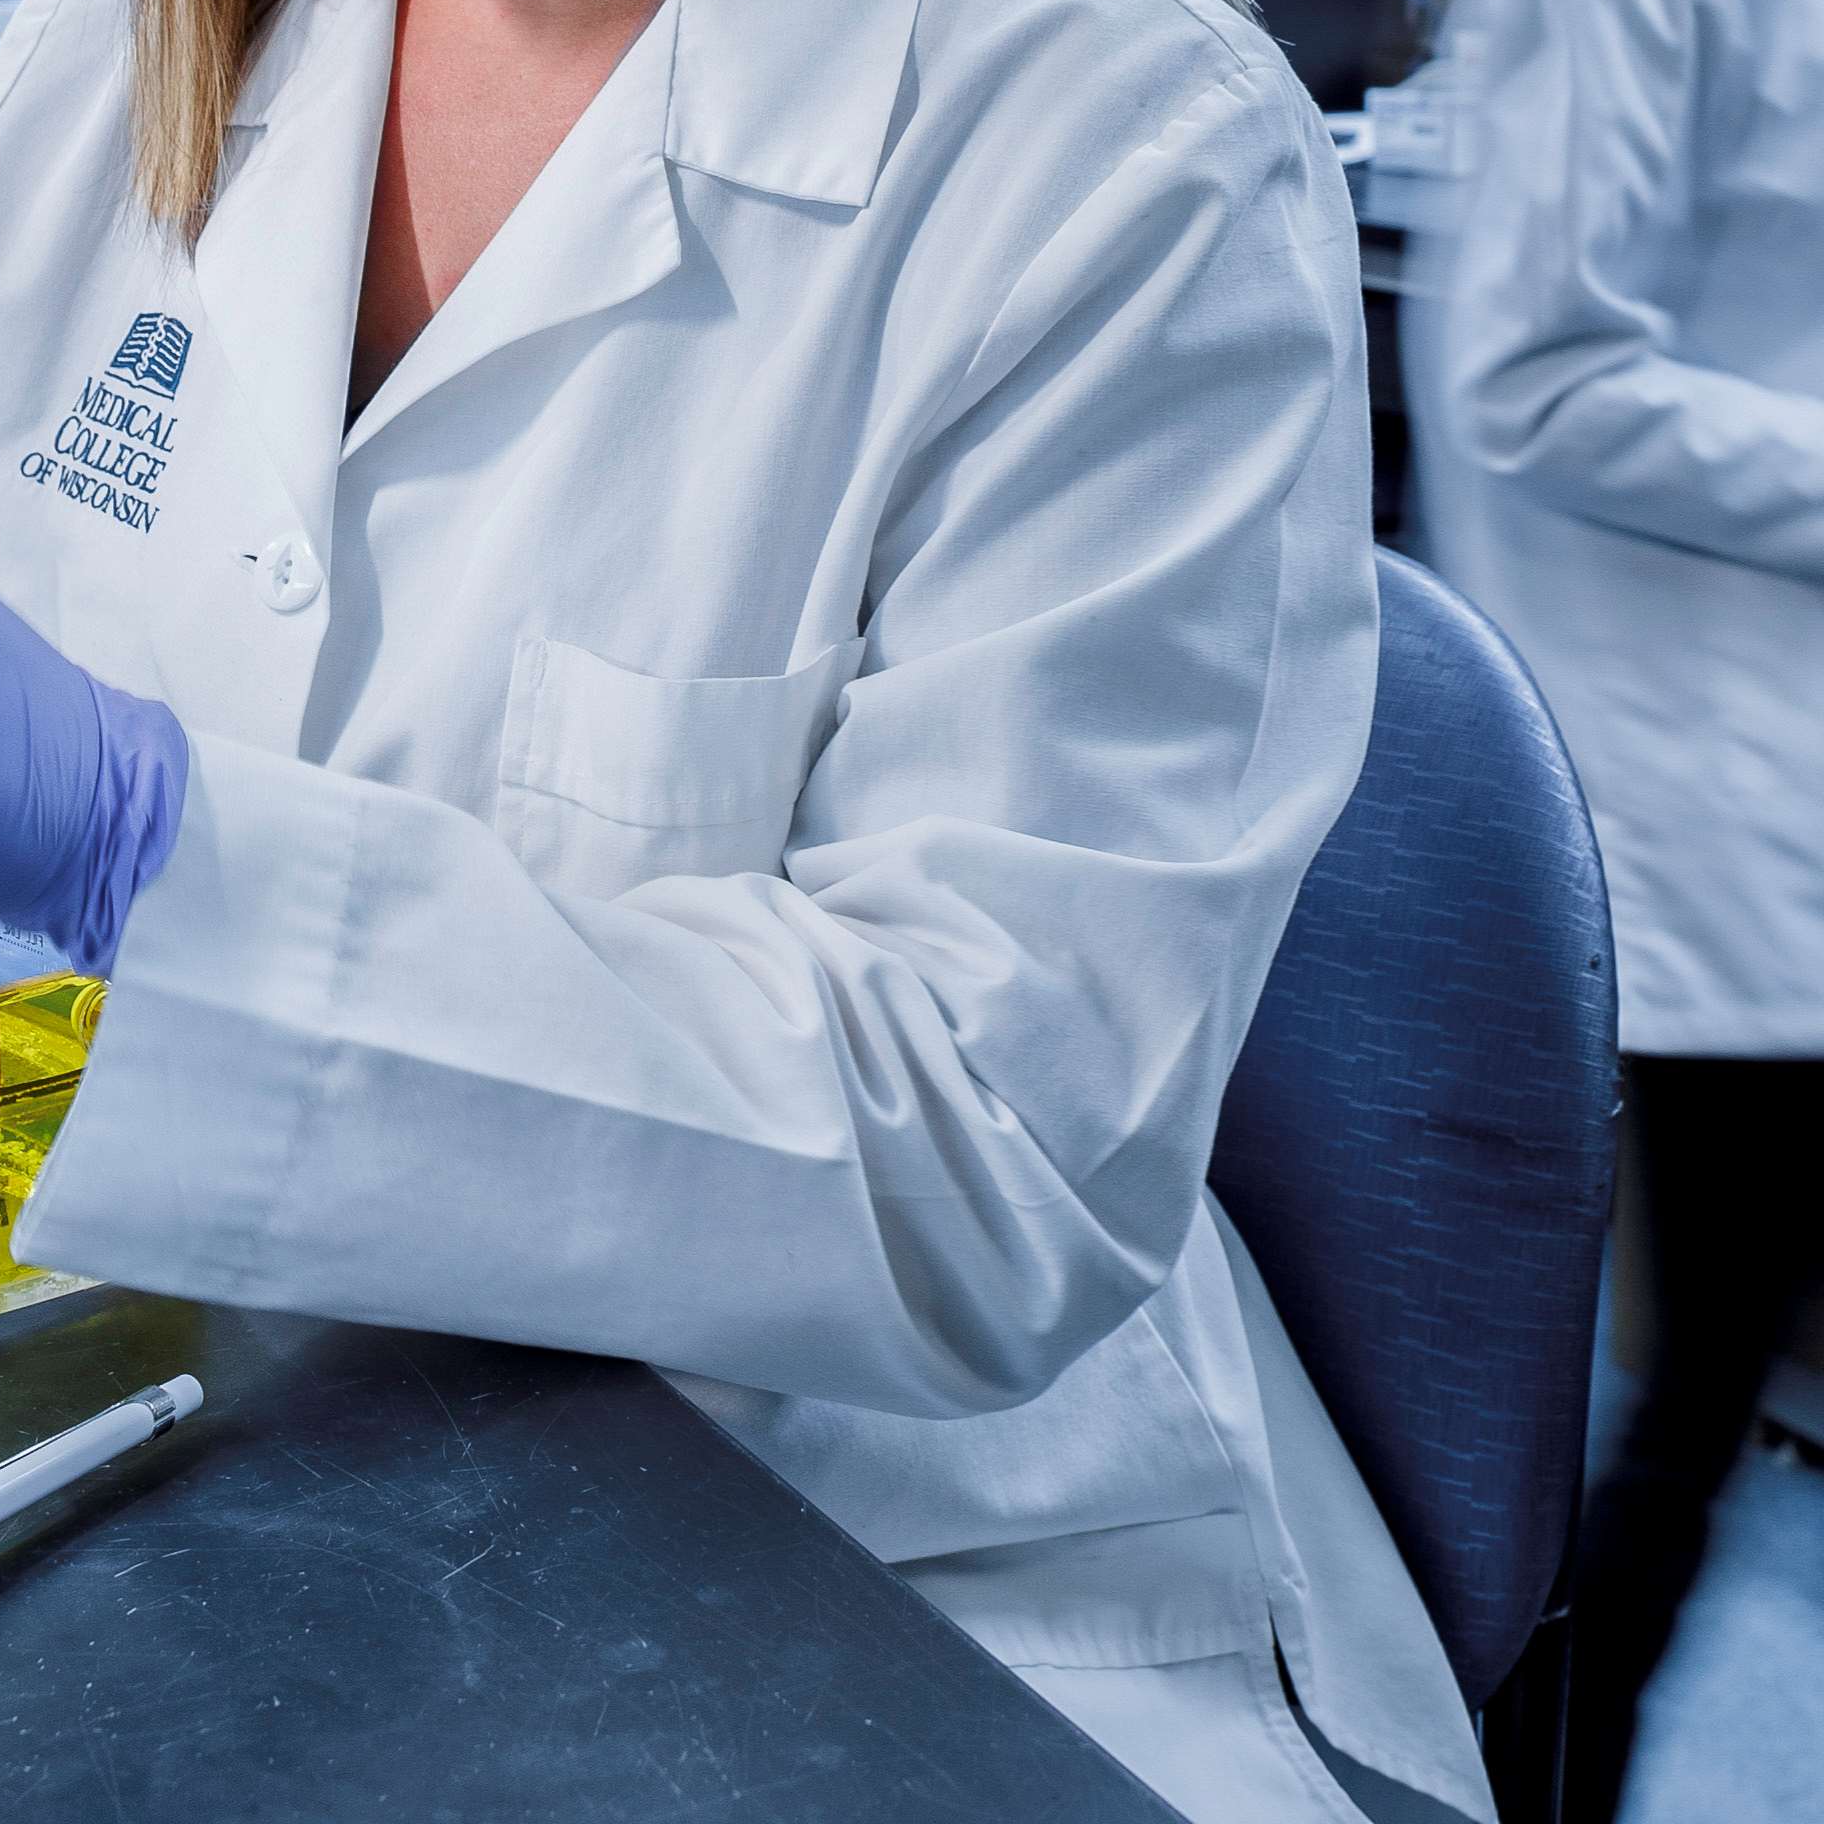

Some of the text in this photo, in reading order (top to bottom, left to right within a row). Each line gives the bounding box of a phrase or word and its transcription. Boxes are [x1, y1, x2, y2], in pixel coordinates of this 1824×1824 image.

[72, 376, 178, 453] MEDICAL
[20, 452, 160, 534] OF WISCONSIN
[54, 415, 166, 494] COLLEGE
